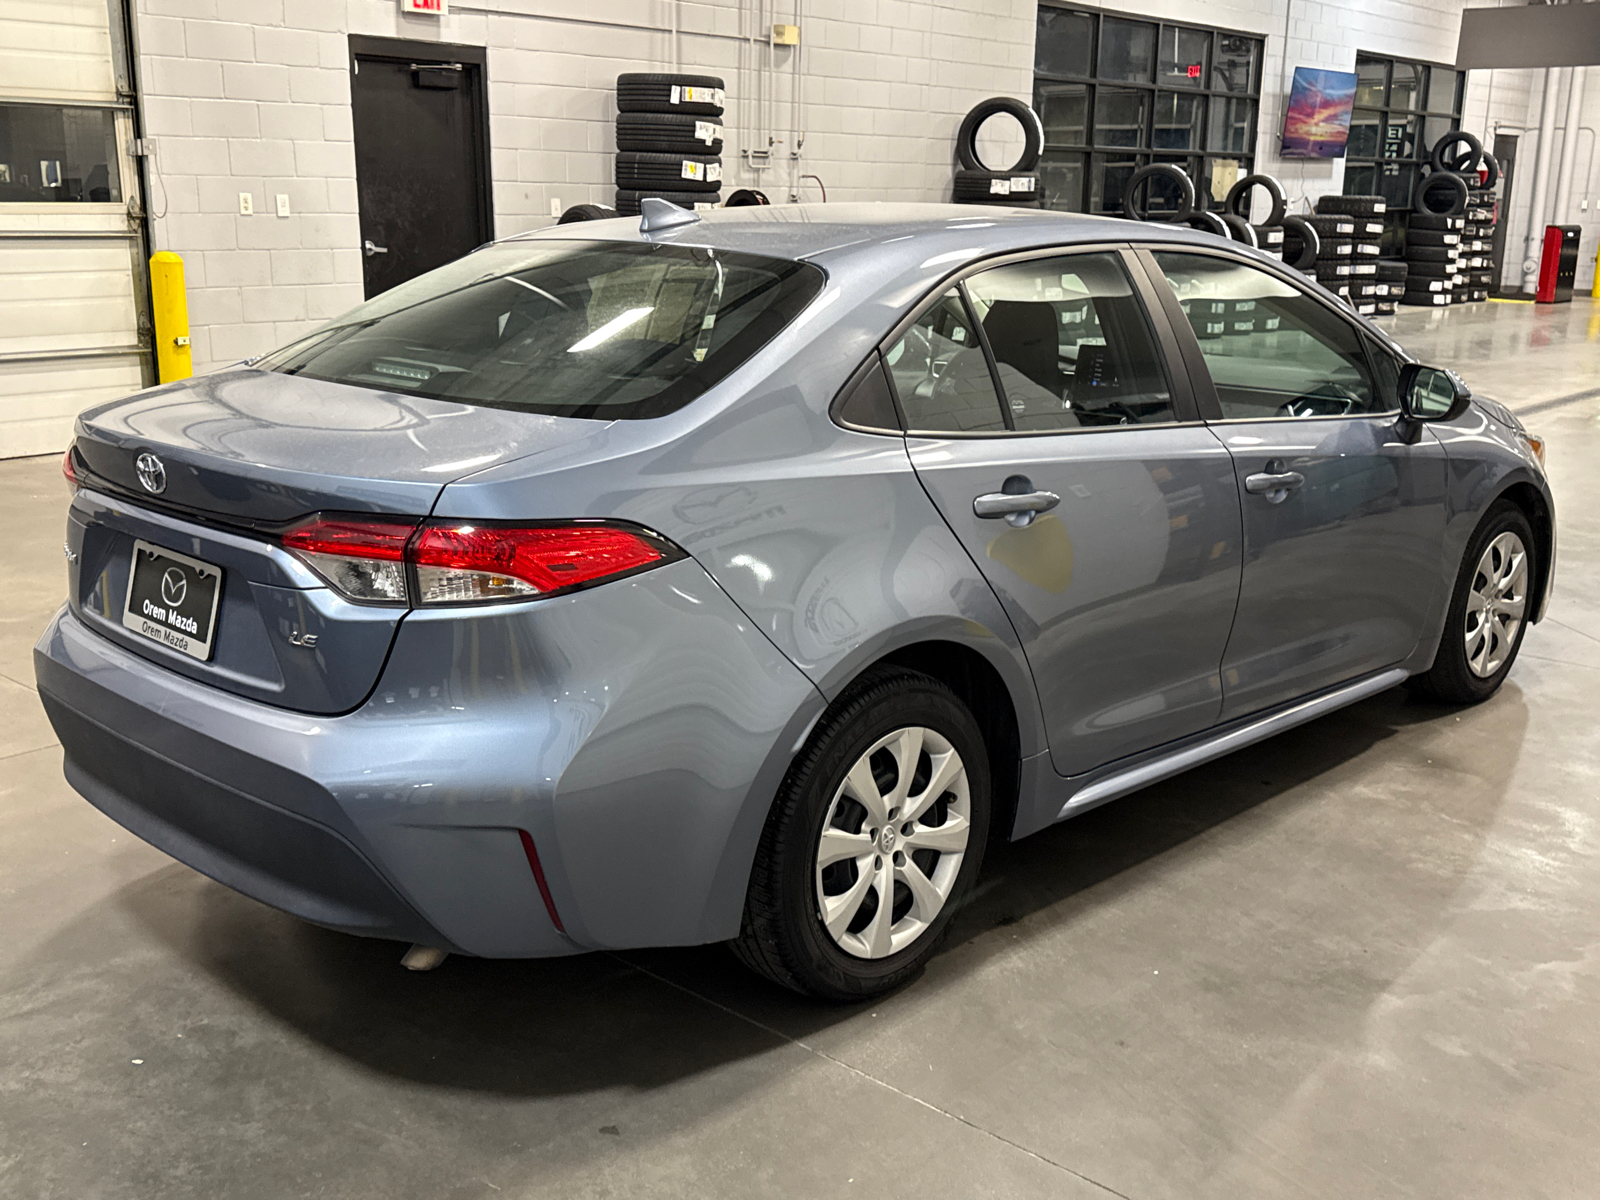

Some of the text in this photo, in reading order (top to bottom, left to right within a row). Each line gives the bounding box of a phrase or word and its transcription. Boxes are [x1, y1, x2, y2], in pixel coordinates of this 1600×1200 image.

[143, 599, 198, 634] Orem Mazda
[142, 621, 189, 651] Orem Mazda
[288, 630, 318, 648] LE
